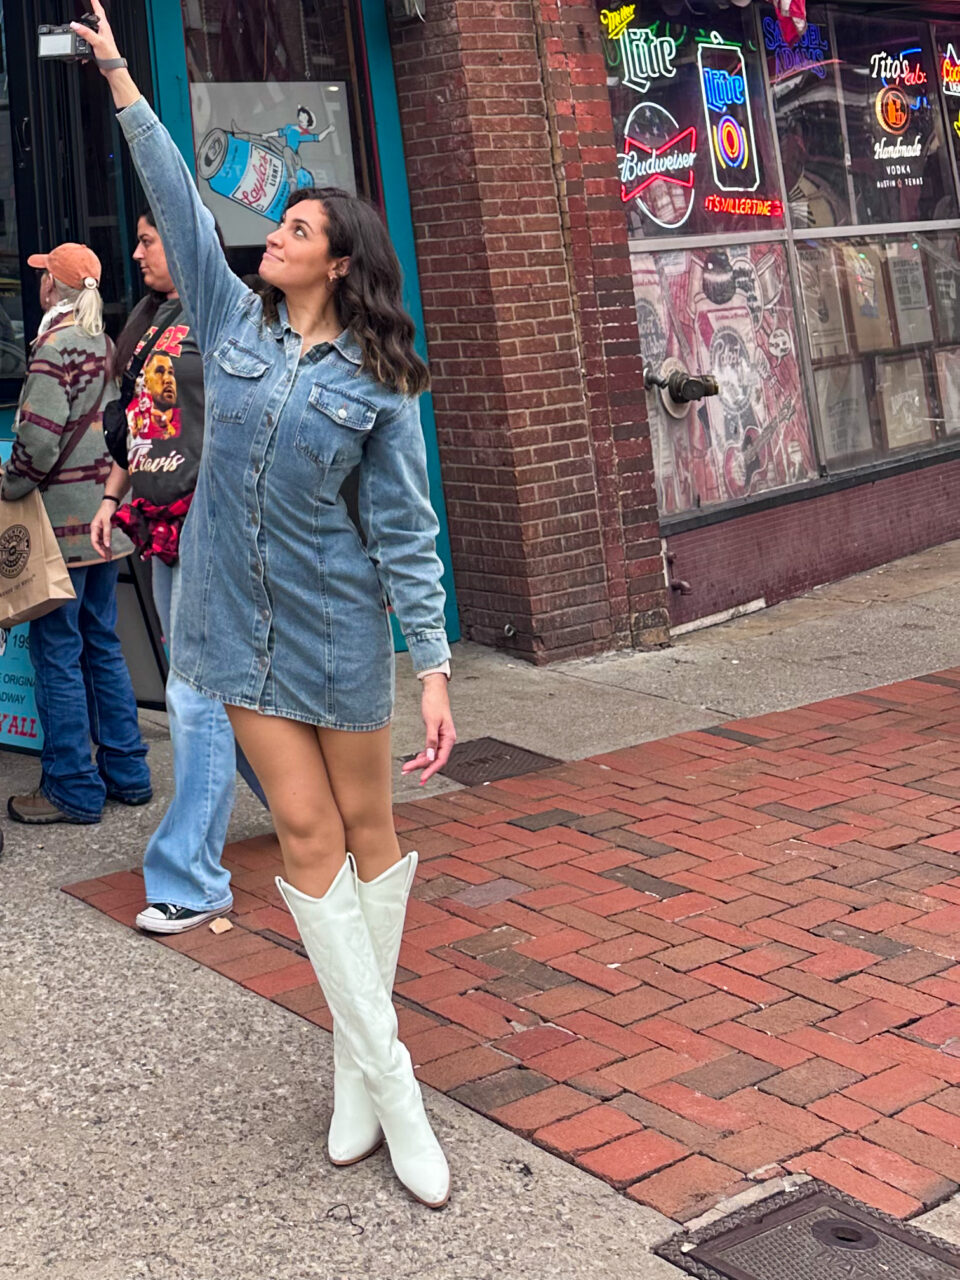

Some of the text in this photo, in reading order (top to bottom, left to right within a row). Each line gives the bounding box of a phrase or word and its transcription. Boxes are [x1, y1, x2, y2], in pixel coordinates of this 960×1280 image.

[600, 4, 636, 36] Miller
[620, 25, 677, 94] Lite
[871, 51, 909, 79] Tito's
[703, 67, 744, 113] Lite
[873, 135, 922, 160] Handmade
[240, 150, 269, 206] Layla's
[269, 163, 279, 187] LIGHT
[617, 151, 697, 182] Budweiser
[886, 165, 912, 176] VODKA
[129, 444, 185, 473] Travis
[13, 633, 31, 649] 199
[3, 672, 37, 687] ORIGIN
